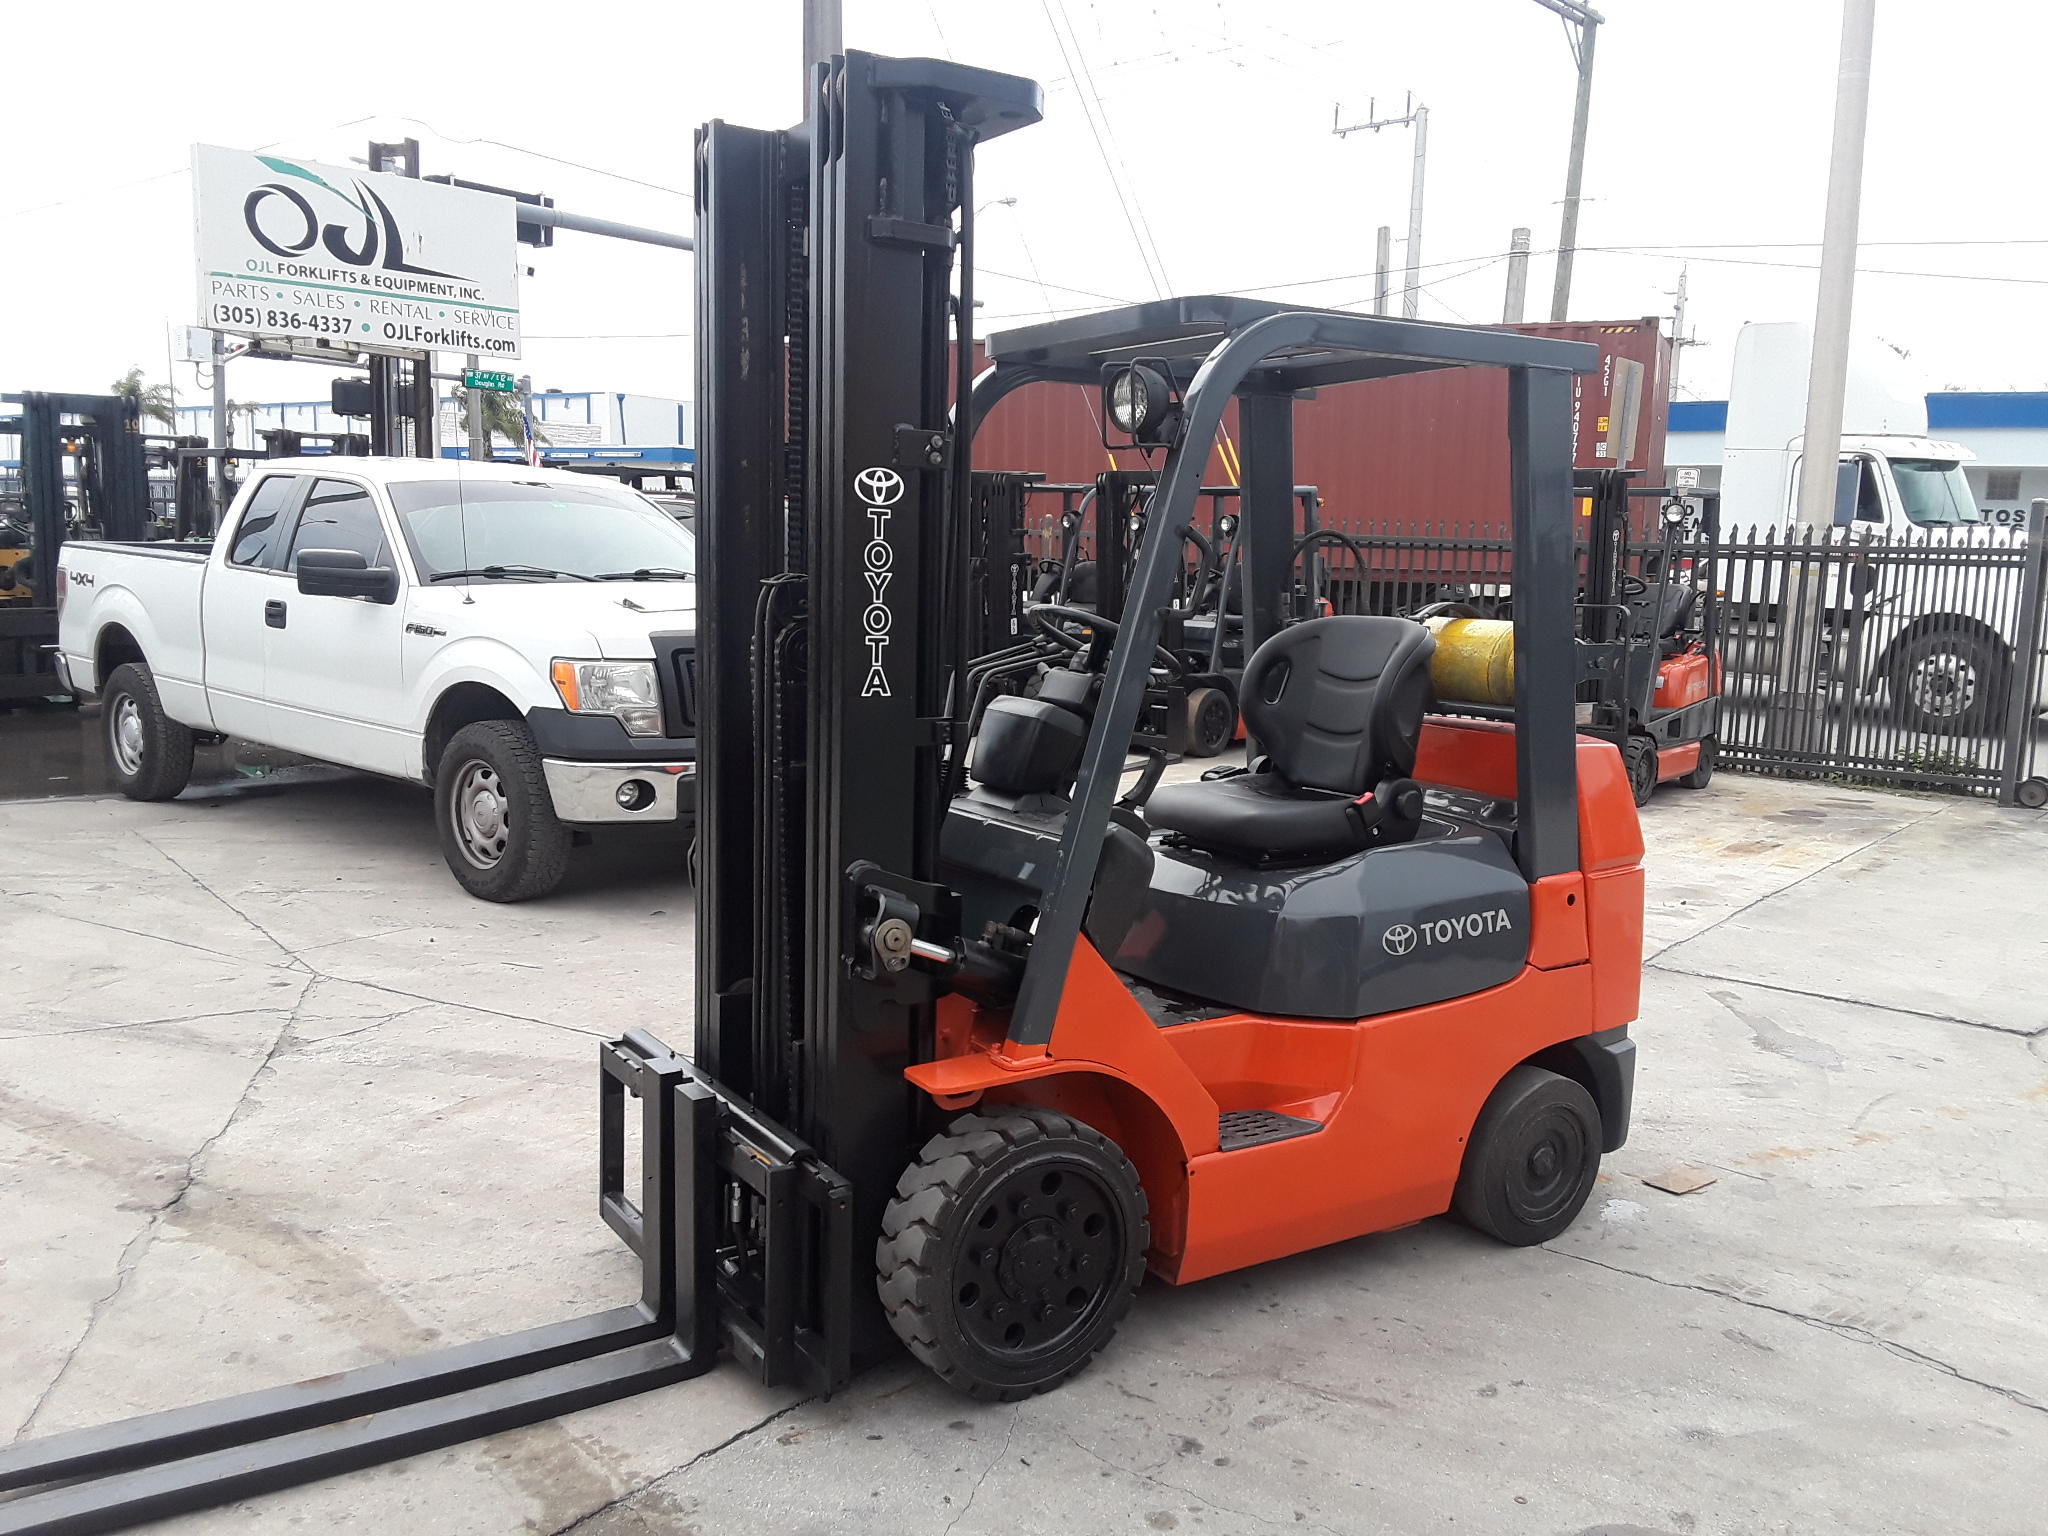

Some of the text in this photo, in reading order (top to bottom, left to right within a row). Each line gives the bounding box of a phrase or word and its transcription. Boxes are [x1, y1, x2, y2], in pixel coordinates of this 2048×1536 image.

[246, 259, 485, 301] OJL FORKLIFTS & EQUIPMENT, INC.
[211, 280, 515, 331] PARTS SALES RENTAL SERVICE
[213, 303, 516, 353] (305) 836-4337 OJLForklifts.com
[860, 507, 893, 697] TOYOTA
[1420, 908, 1512, 946] TOYOTA
